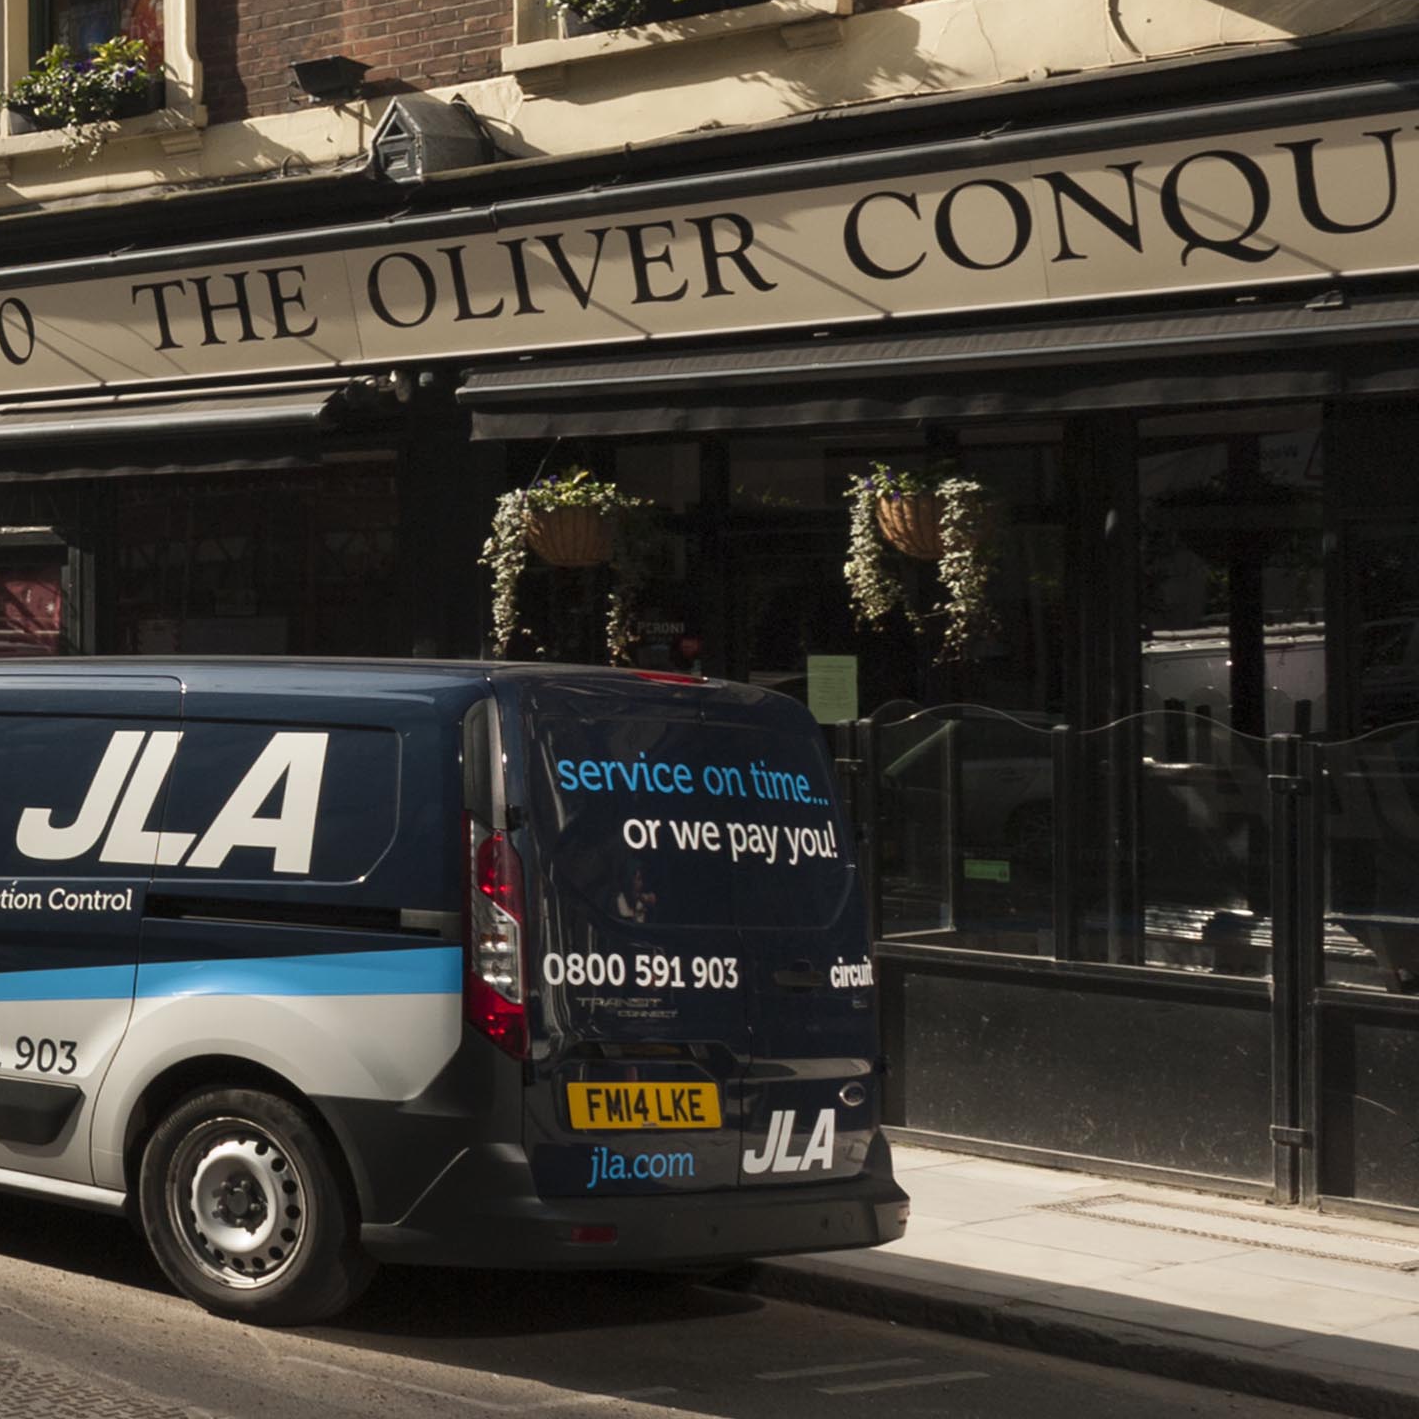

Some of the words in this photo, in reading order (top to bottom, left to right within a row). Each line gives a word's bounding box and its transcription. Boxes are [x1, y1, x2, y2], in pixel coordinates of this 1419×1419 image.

[131, 264, 320, 353] THE
[366, 211, 779, 330] OLIVER
[842, 126, 1419, 281] CONQU
[557, 751, 694, 794] service
[702, 764, 746, 797] on
[749, 760, 829, 806] time...
[16, 730, 330, 874] JLA
[623, 818, 661, 850] or
[669, 820, 721, 851] we
[726, 821, 779, 864] pay
[783, 820, 839, 865] you!
[48, 887, 133, 911] Control
[542, 953, 626, 986] 0800
[634, 956, 686, 988] 591
[691, 956, 739, 989] 903
[830, 955, 875, 989] circuit
[575, 996, 662, 1008] TRANSIT
[14, 1036, 79, 1075] 903
[585, 1088, 649, 1123] FM14
[655, 1088, 705, 1122] LKE
[742, 1108, 836, 1175] JLA
[587, 1146, 696, 1190] jla.com
